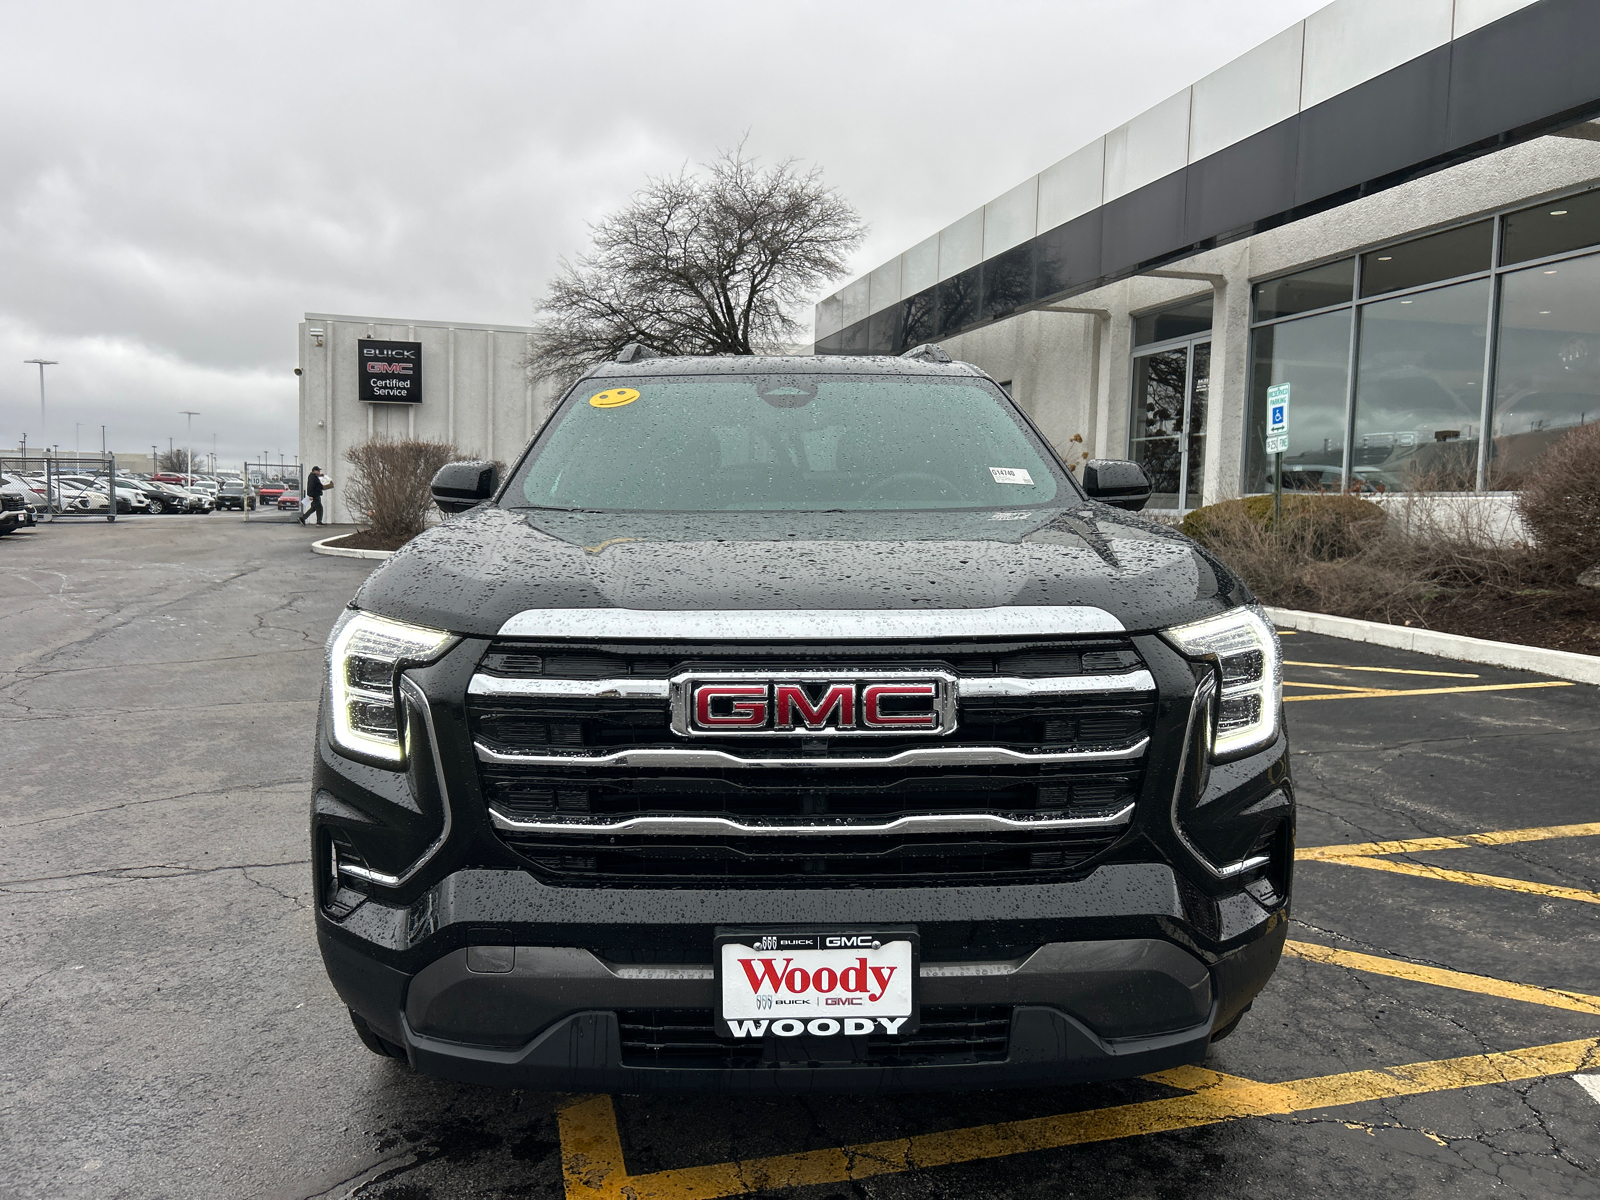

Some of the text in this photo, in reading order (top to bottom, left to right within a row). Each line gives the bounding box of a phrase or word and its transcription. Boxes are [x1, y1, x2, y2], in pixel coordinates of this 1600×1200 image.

[363, 348, 416, 359] BUICK
[367, 361, 413, 375] GMC
[370, 378, 410, 388] Certified
[373, 387, 408, 397] Service
[1268, 388, 1288, 398] RESERVED
[1269, 396, 1286, 406] PARKING
[694, 684, 937, 729] GMC
[825, 936, 873, 947] GMC
[737, 957, 898, 1003] Woody
[825, 997, 863, 1006] GMC
[727, 1017, 909, 1038] WOODY
